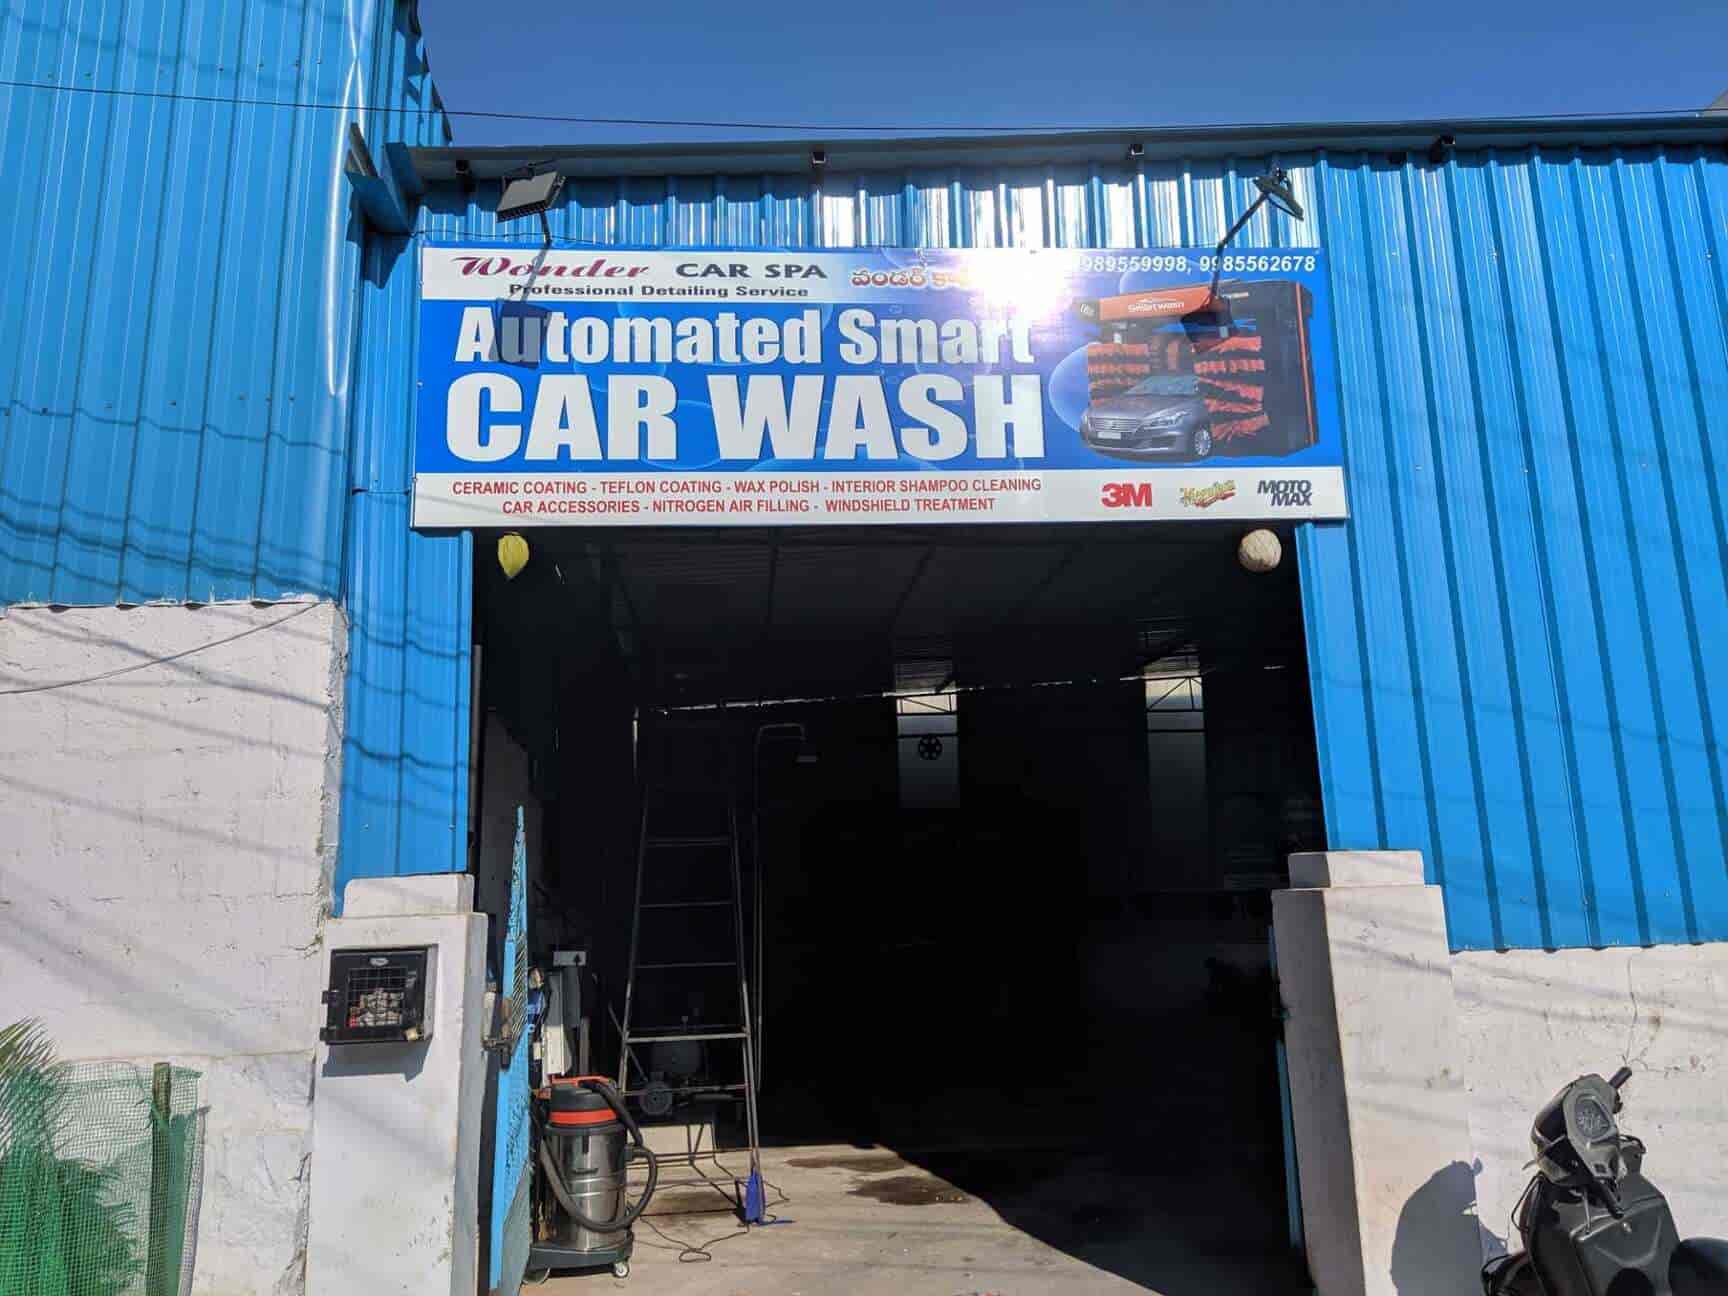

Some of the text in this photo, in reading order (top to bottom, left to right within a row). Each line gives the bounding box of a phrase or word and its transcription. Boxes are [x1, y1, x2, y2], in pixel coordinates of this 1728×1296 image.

[450, 256, 828, 279] Wonder CAR SPA
[509, 284, 809, 298] Professional Detailing Service
[455, 306, 1036, 365] Automated Smart
[446, 372, 1046, 462] CAR WASH
[452, 481, 519, 495] CERAMIC
[523, 481, 587, 494] COATING
[601, 480, 656, 494] TEFLON
[659, 480, 722, 493] COATING
[734, 480, 766, 493] WAX
[769, 480, 820, 493] POLISH
[832, 480, 896, 493] INTERIOR
[900, 479, 968, 492] SHAMPOO
[972, 478, 1041, 492] CLEANING
[1257, 480, 1312, 494] MOTO
[1101, 483, 1152, 508] 3M
[1271, 492, 1312, 506] MAX
[502, 501, 532, 514] CAR
[537, 500, 640, 513] ACCESSORIES
[652, 500, 725, 513] NITROGEN
[729, 500, 752, 513] AIR
[757, 500, 809, 513] FILLING
[825, 499, 910, 512] WINDSHIELD
[915, 498, 995, 511] TREATMENT
